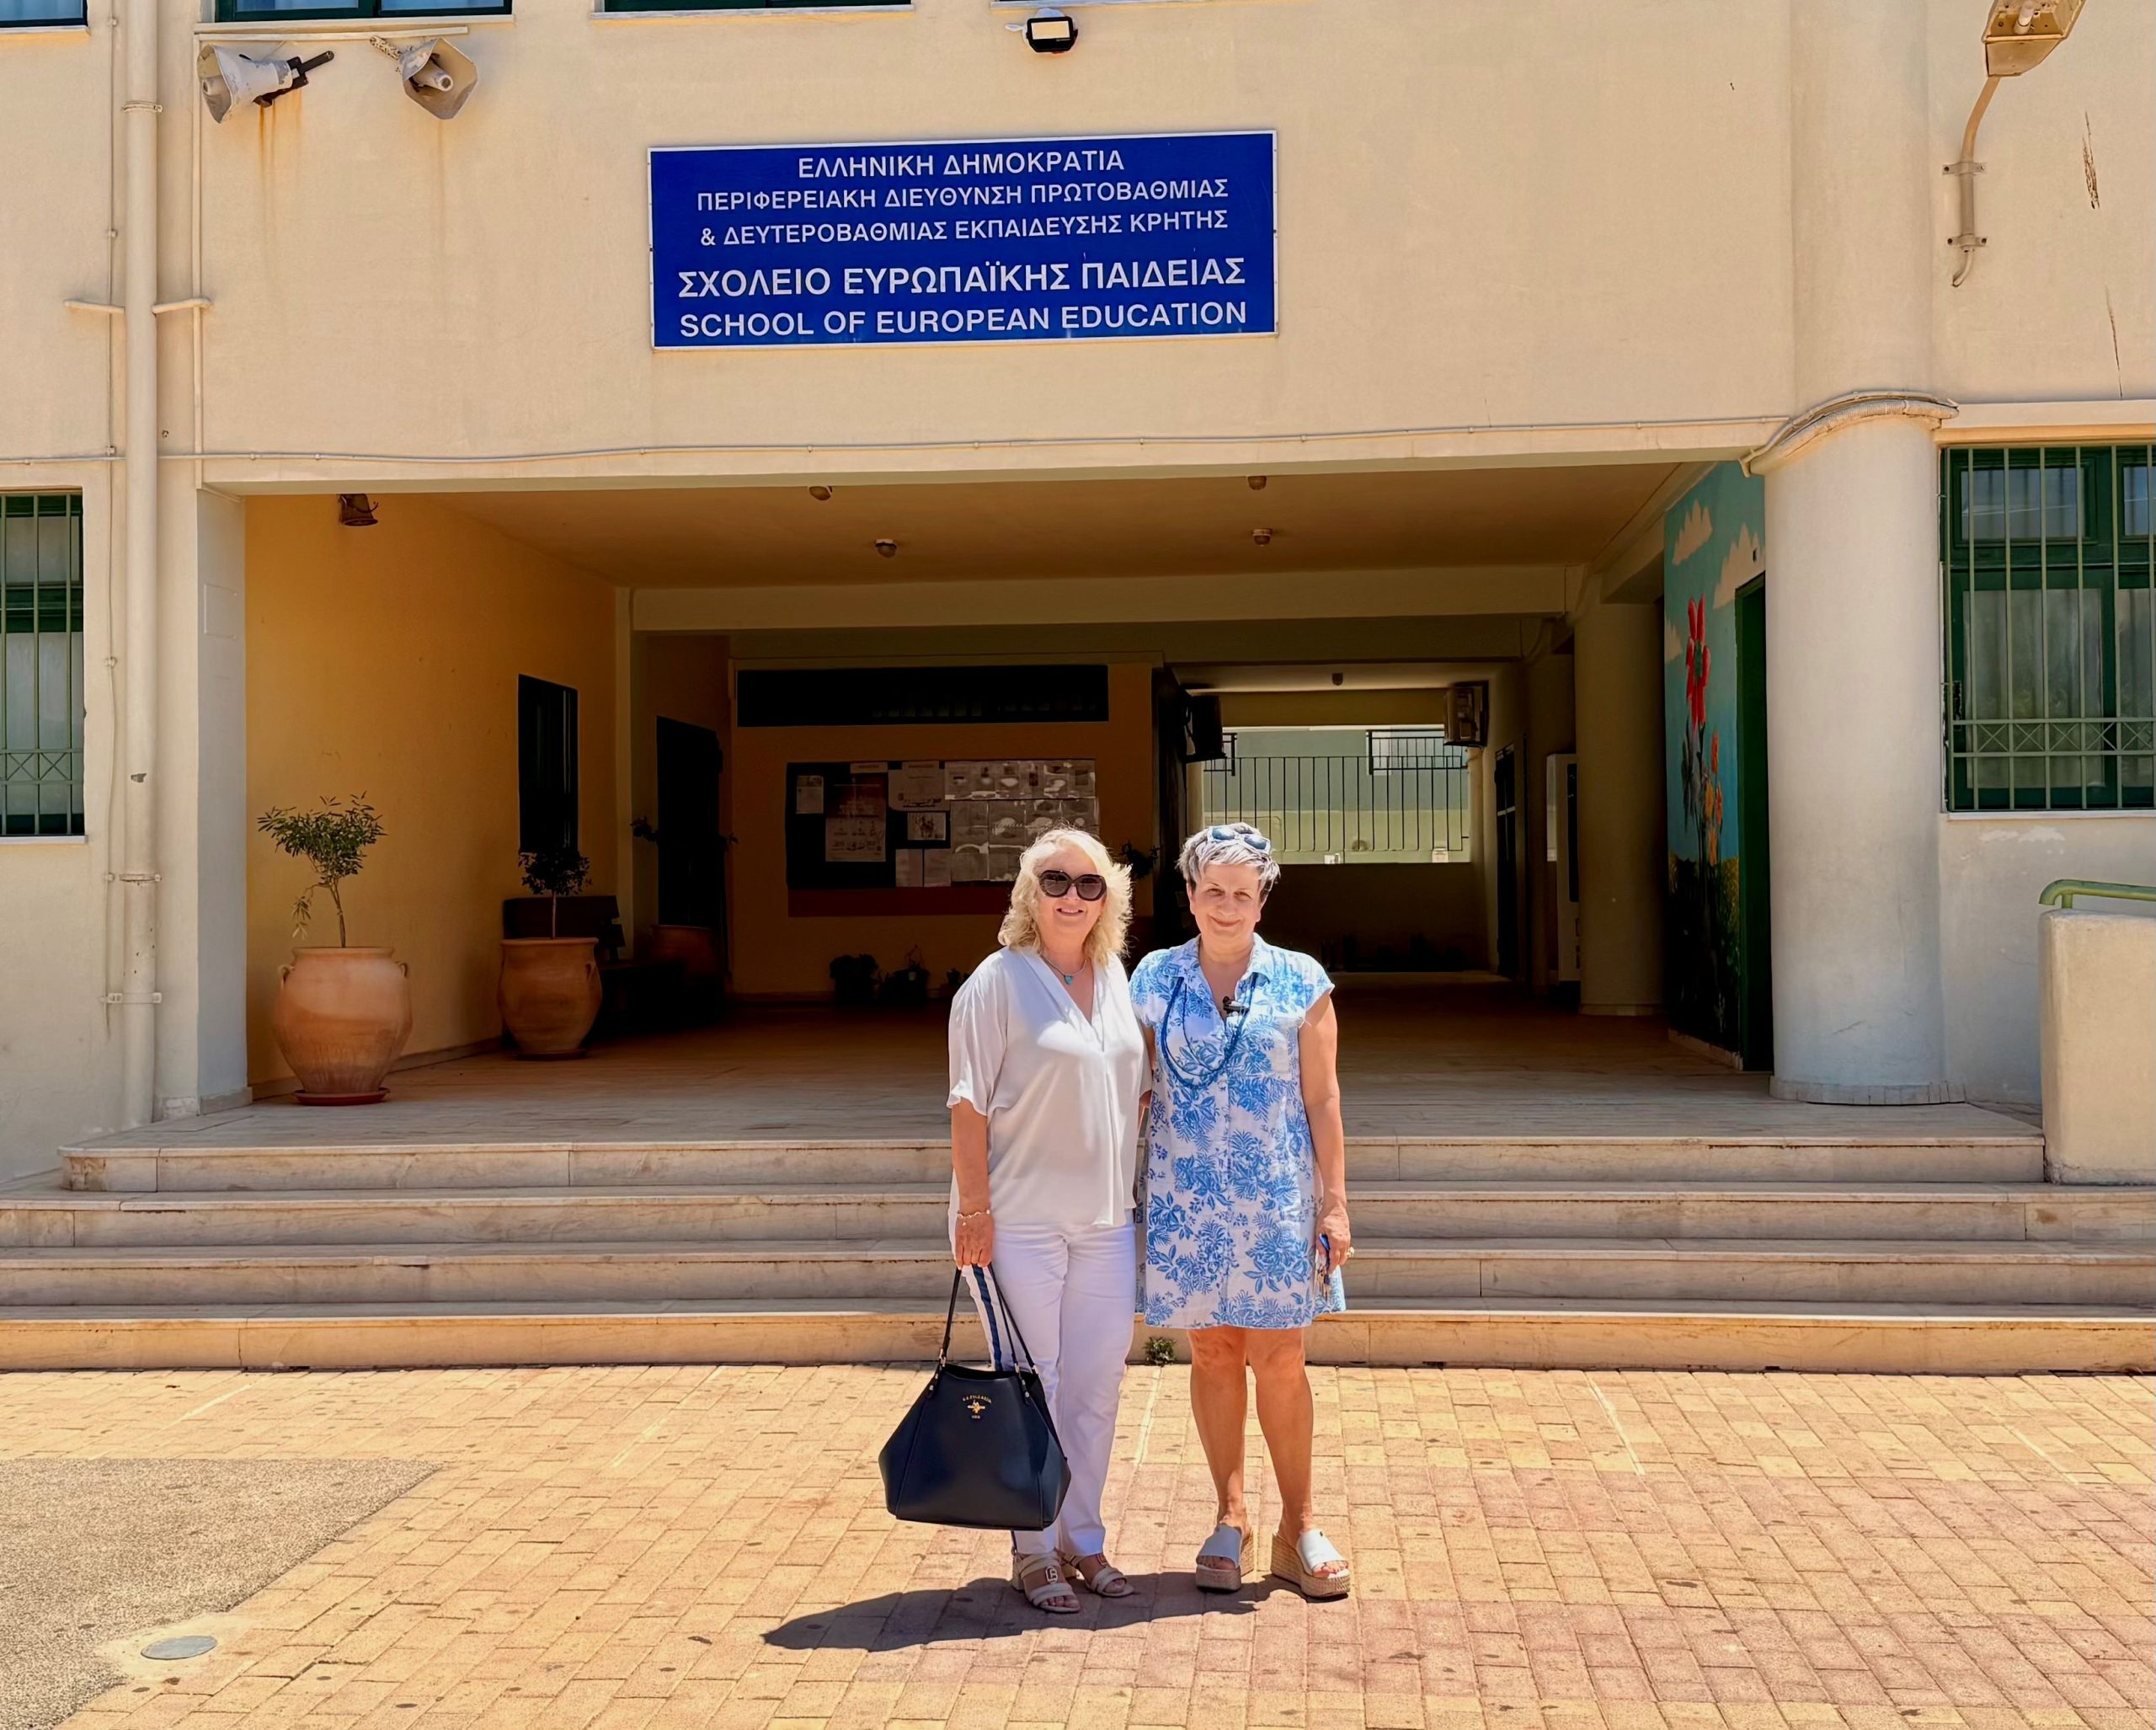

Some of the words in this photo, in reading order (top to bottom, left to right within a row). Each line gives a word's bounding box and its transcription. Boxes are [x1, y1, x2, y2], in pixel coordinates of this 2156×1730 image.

[798, 156, 934, 178] ΕΛΛΗΝΙΚΗ
[943, 150, 1124, 175] ΔΗΜΟΚΡΑΤΙΑ
[697, 190, 876, 211] ΠΕΡΙΦΕΡΕΙΑΚΗ
[884, 185, 1022, 207] ΔΙΕΥΘΥΝΣΗ
[1031, 179, 1229, 203] ΠΡΩΤΟΒΑΘΜΙΑΣ
[701, 227, 716, 246] &
[723, 221, 947, 245] ΔΕΥΤΕΡΟΒΑΘΜΙΑΣ
[955, 215, 1123, 239] ΕΚΠΑΙΔΕΥΣΗΣ
[1130, 210, 1229, 232] ΚΡΗΤΗΣ
[678, 267, 830, 298] ΣΧΟΛΕΙΟ
[844, 261, 1070, 295] ΕΥΡΩΠΑΪΚΗΣ
[1082, 257, 1246, 289] ΠΑΙΔΕΙΑΣ
[680, 312, 814, 338] SCHOOL
[824, 311, 866, 334] OF
[877, 307, 1049, 334] EUROPEAN
[1061, 301, 1246, 328] EDUCATION
